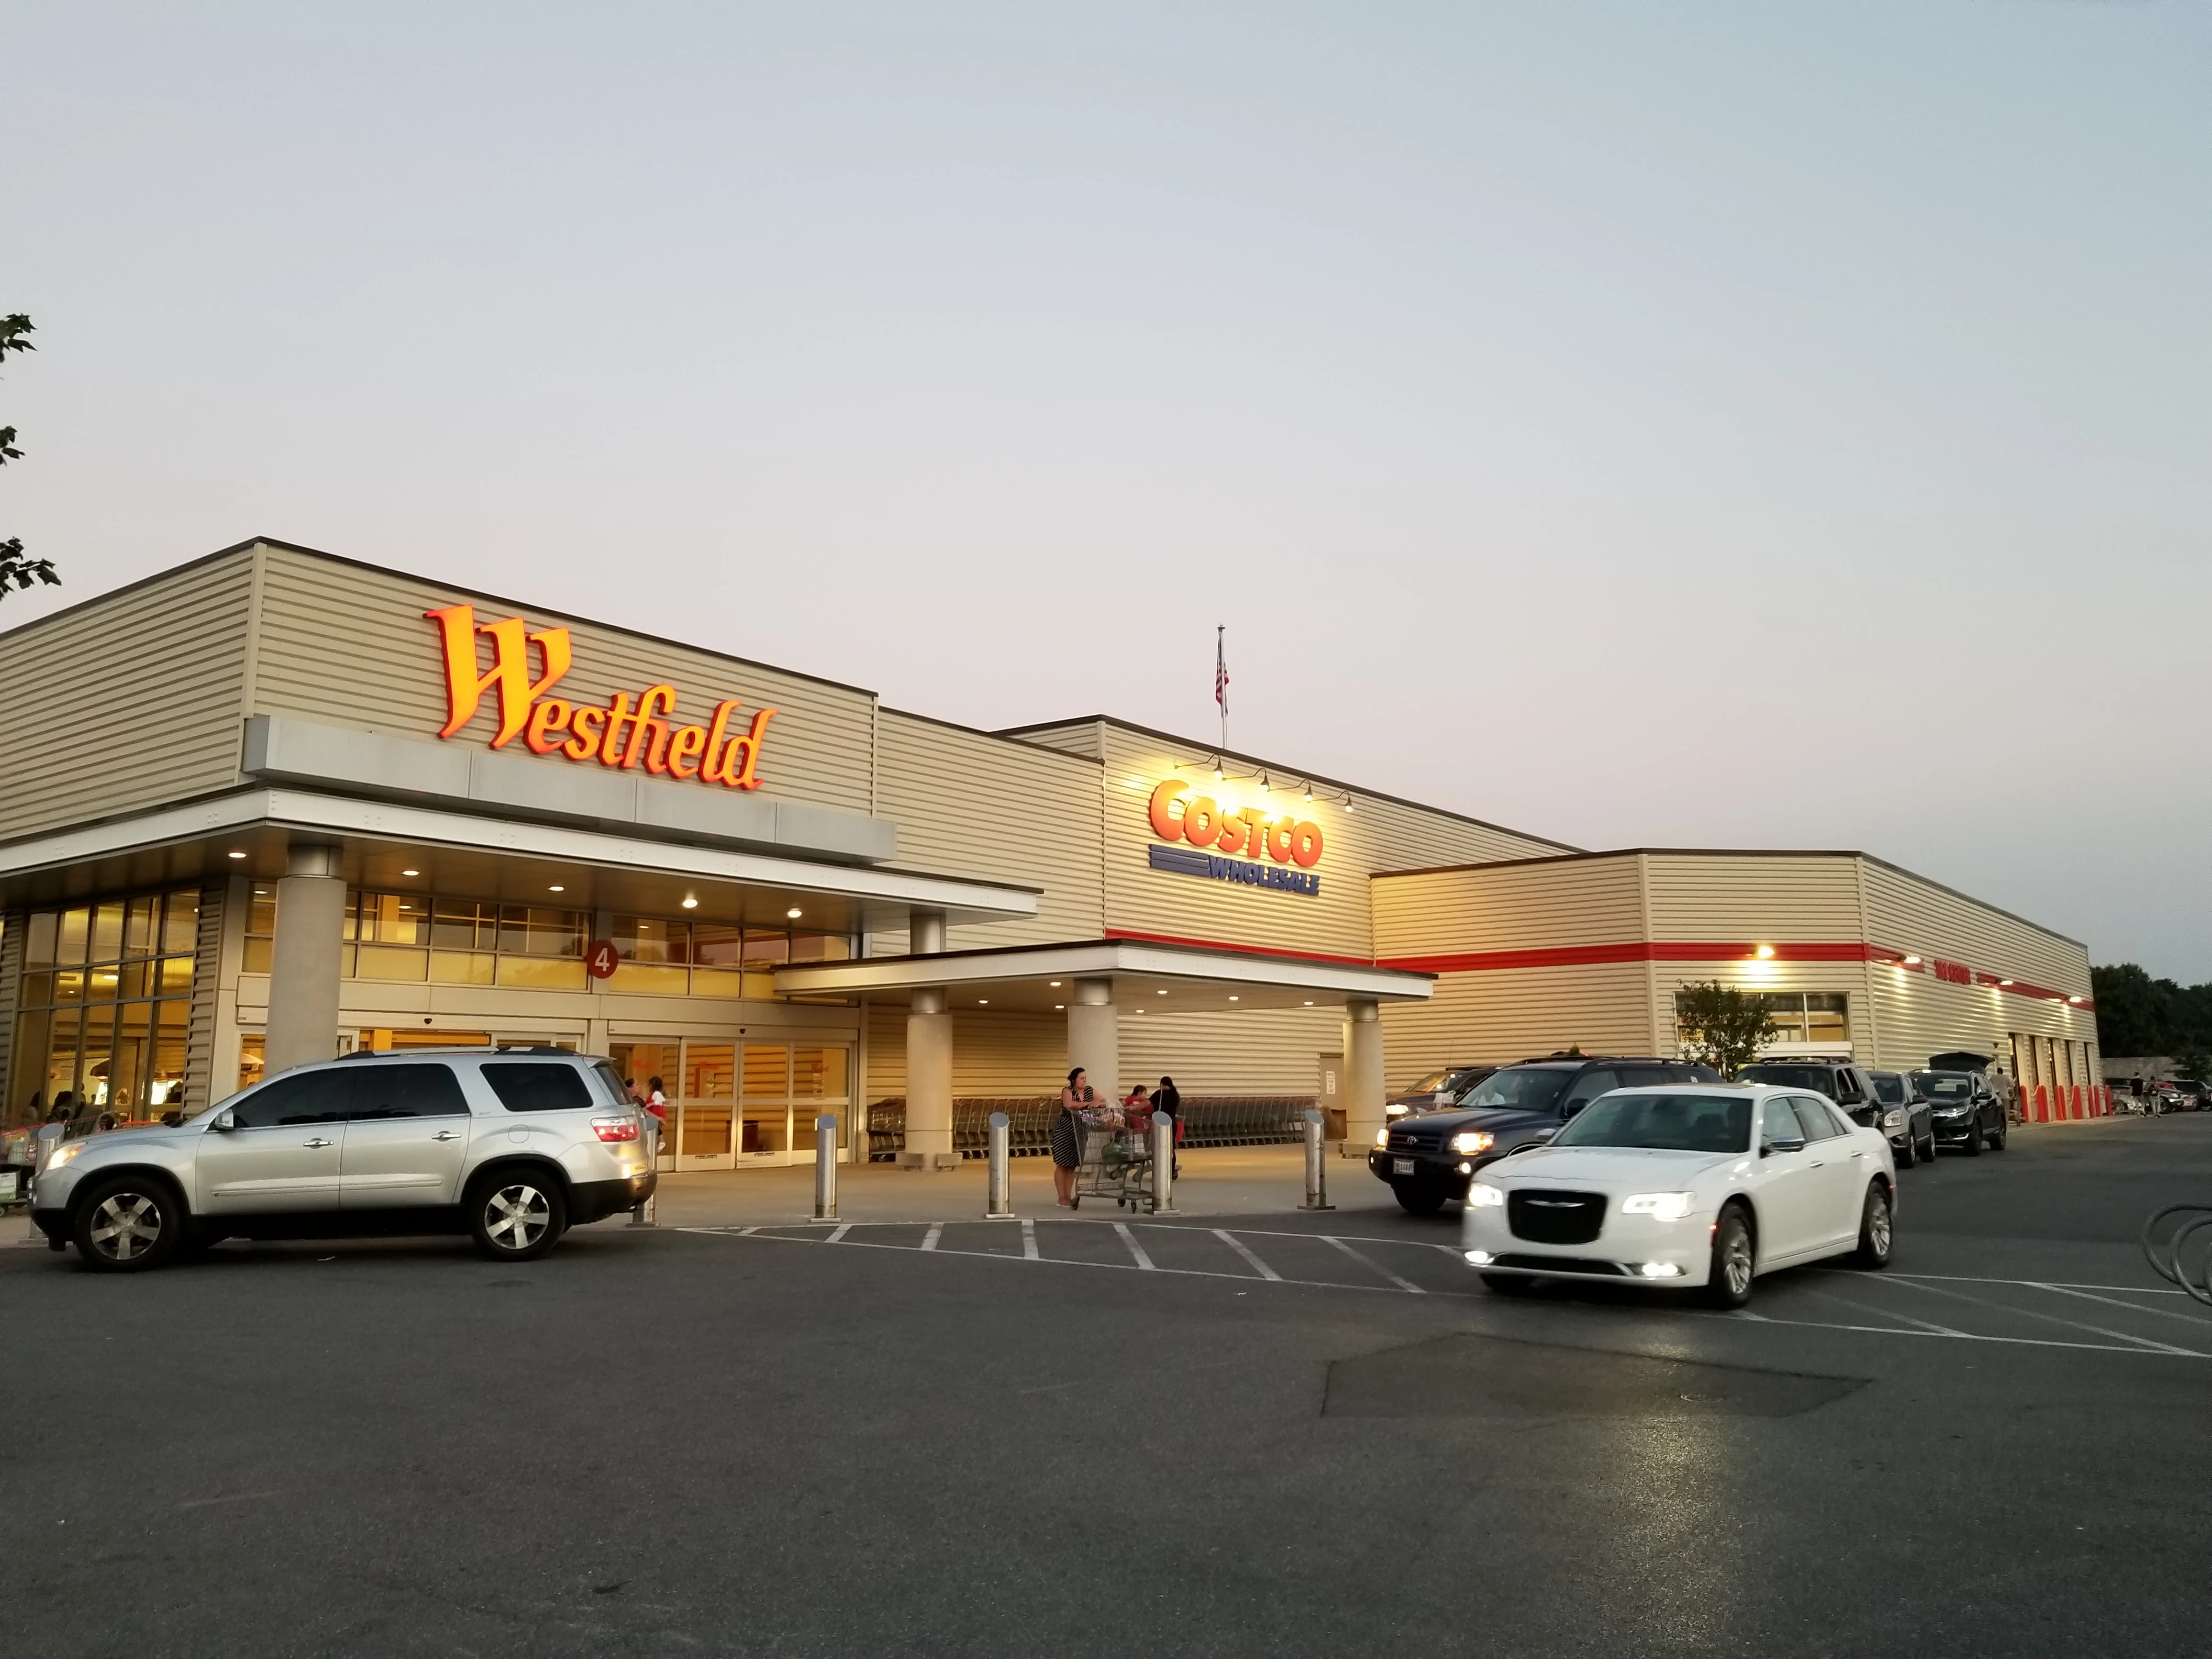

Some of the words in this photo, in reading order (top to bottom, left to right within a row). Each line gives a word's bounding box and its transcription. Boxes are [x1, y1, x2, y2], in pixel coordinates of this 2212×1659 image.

[422, 604, 778, 791] Westfield
[1148, 780, 1323, 867] COSTCO
[1209, 855, 1321, 896] WHOLESALE
[595, 947, 610, 972] 4
